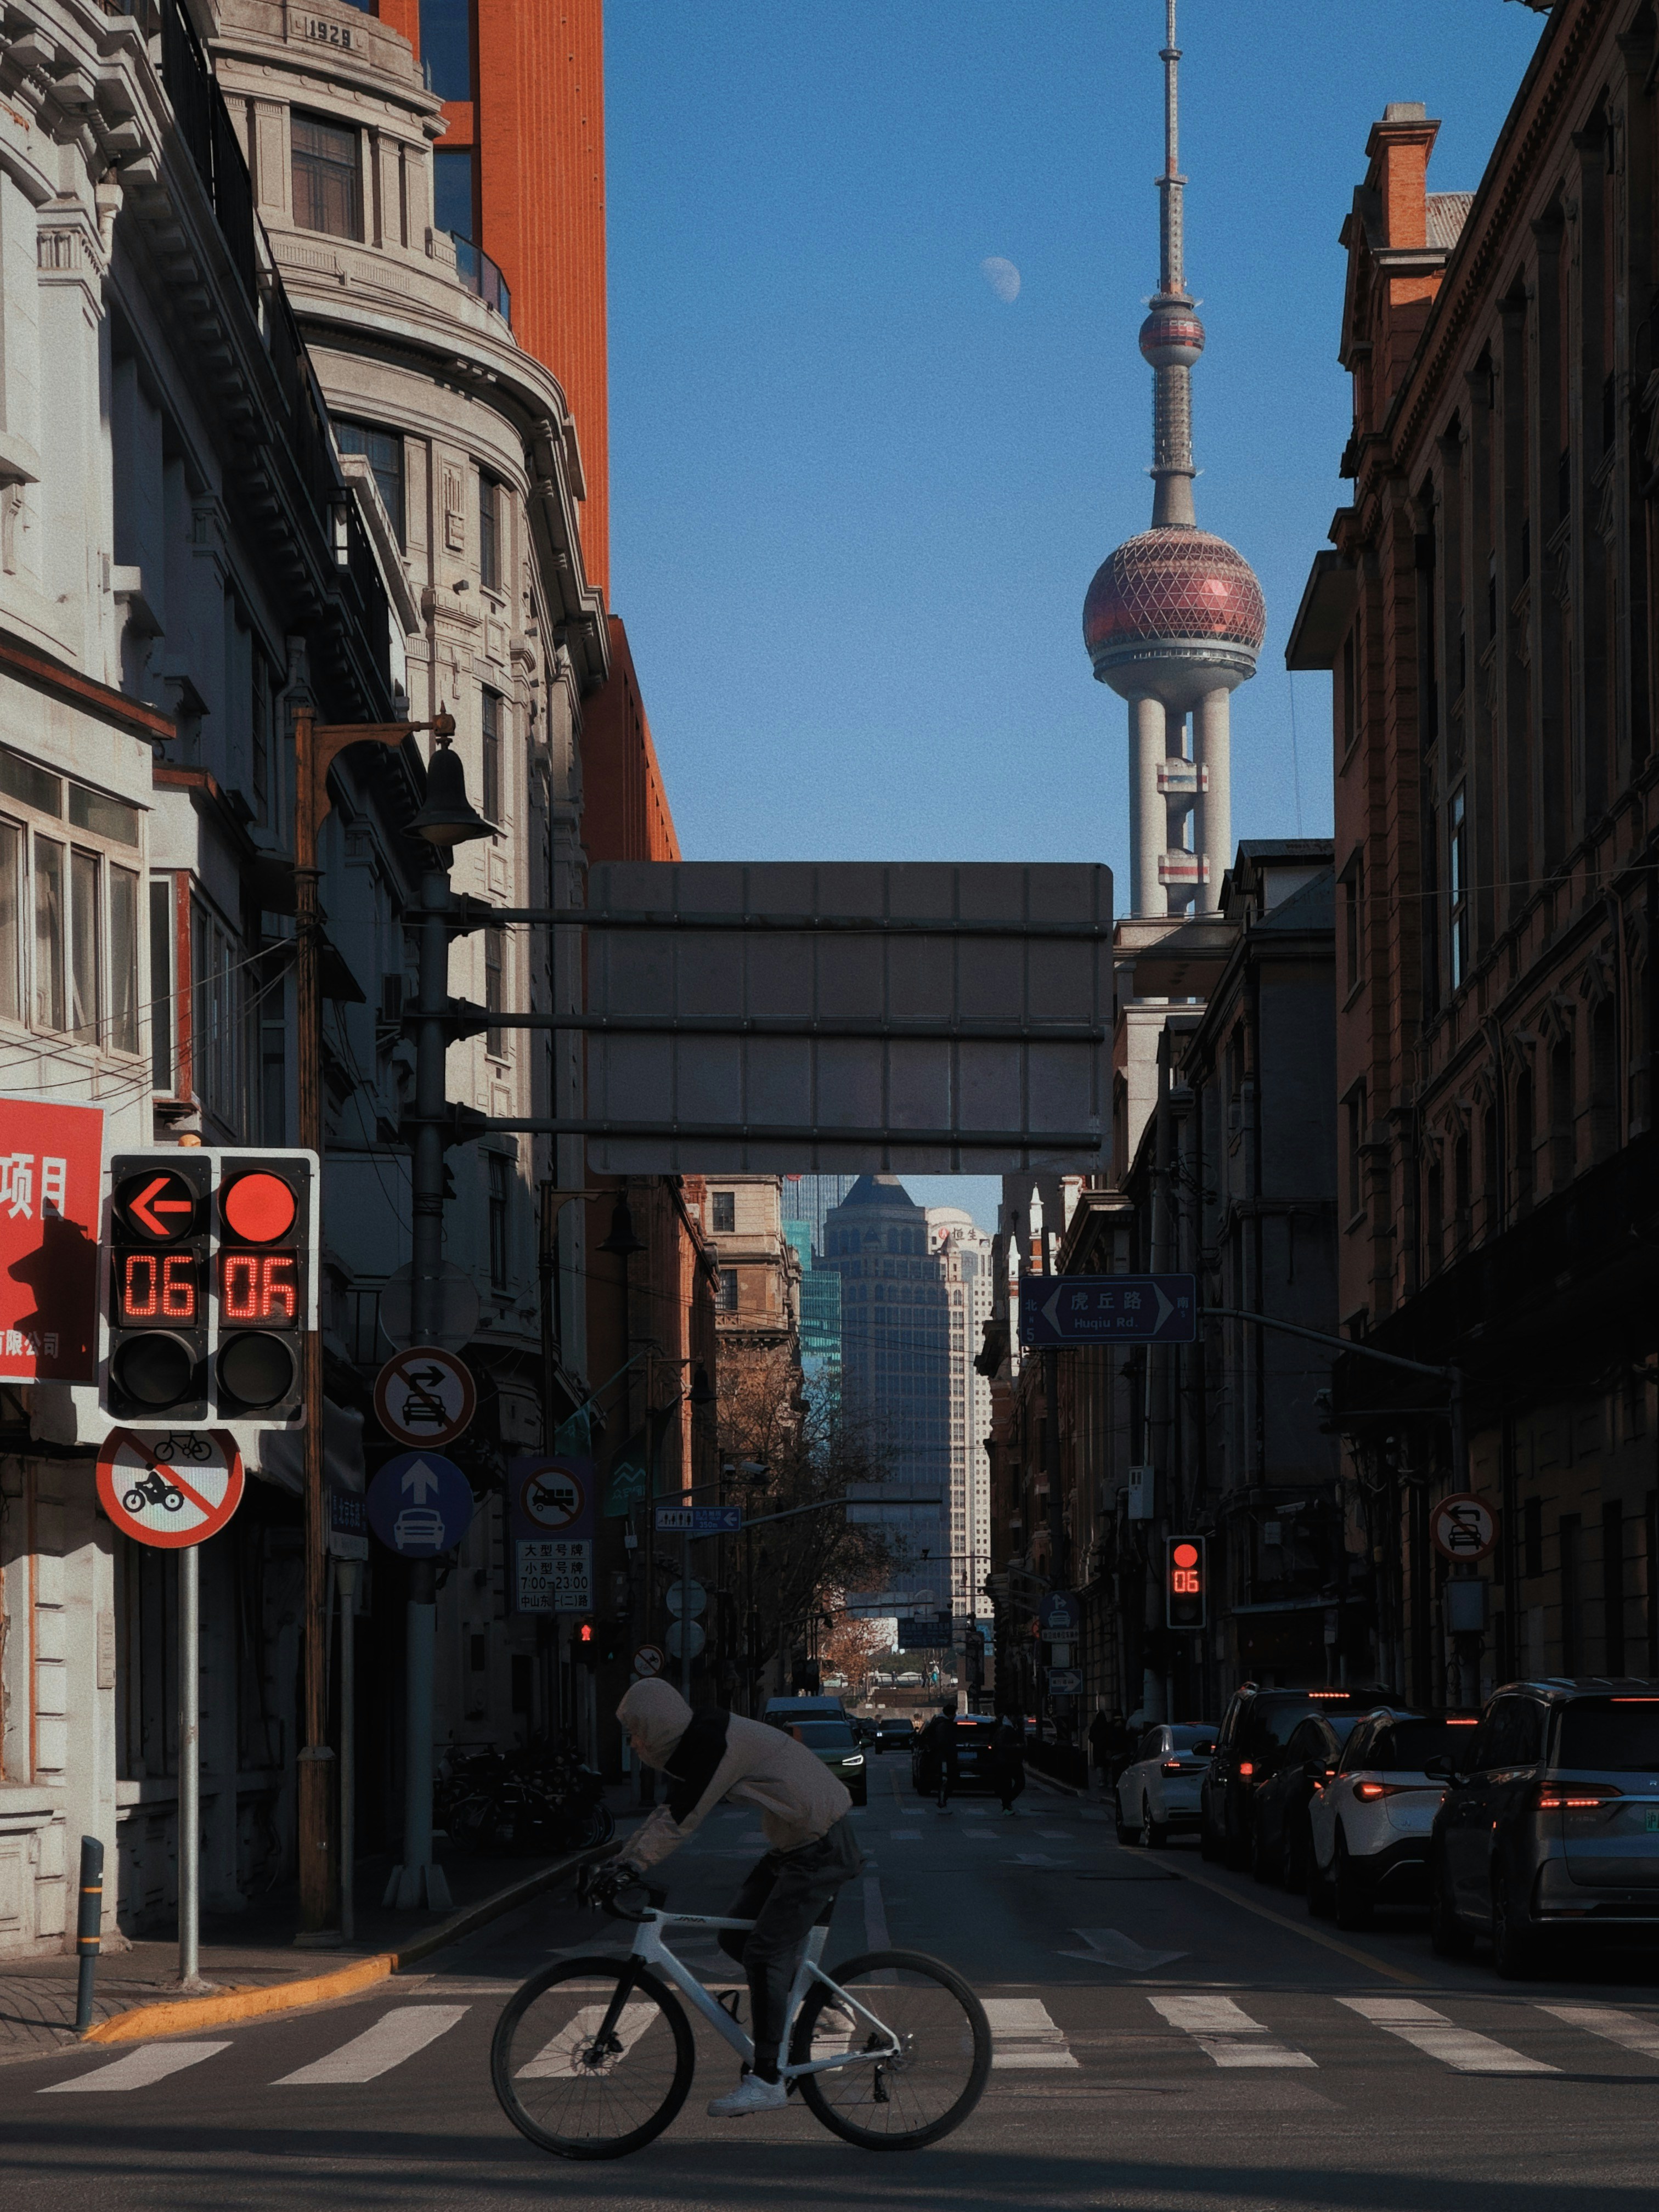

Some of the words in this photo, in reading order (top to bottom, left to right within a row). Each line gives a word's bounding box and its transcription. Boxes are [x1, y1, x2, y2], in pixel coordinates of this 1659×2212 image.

[0, 1153, 66, 1220] 项目
[952, 1228, 977, 1240] 恒生
[127, 1256, 194, 1316] 06
[1025, 1299, 1037, 1311] 北
[1071, 1291, 1142, 1310] 虎丘路
[1177, 1296, 1189, 1309] 南
[1075, 1318, 1110, 1330] Huqiu
[1116, 1317, 1138, 1327] Rd.
[1026, 1328, 1035, 1342] 5
[0, 1330, 59, 1359] 限公司
[525, 1544, 583, 1556] 大型号牌
[526, 1562, 583, 1575] 小型号牌
[521, 1577, 587, 1589] 7:00-23:00
[1174, 1571, 1199, 1593] 06
[1647, 1812, 1659, 1829] 沪
